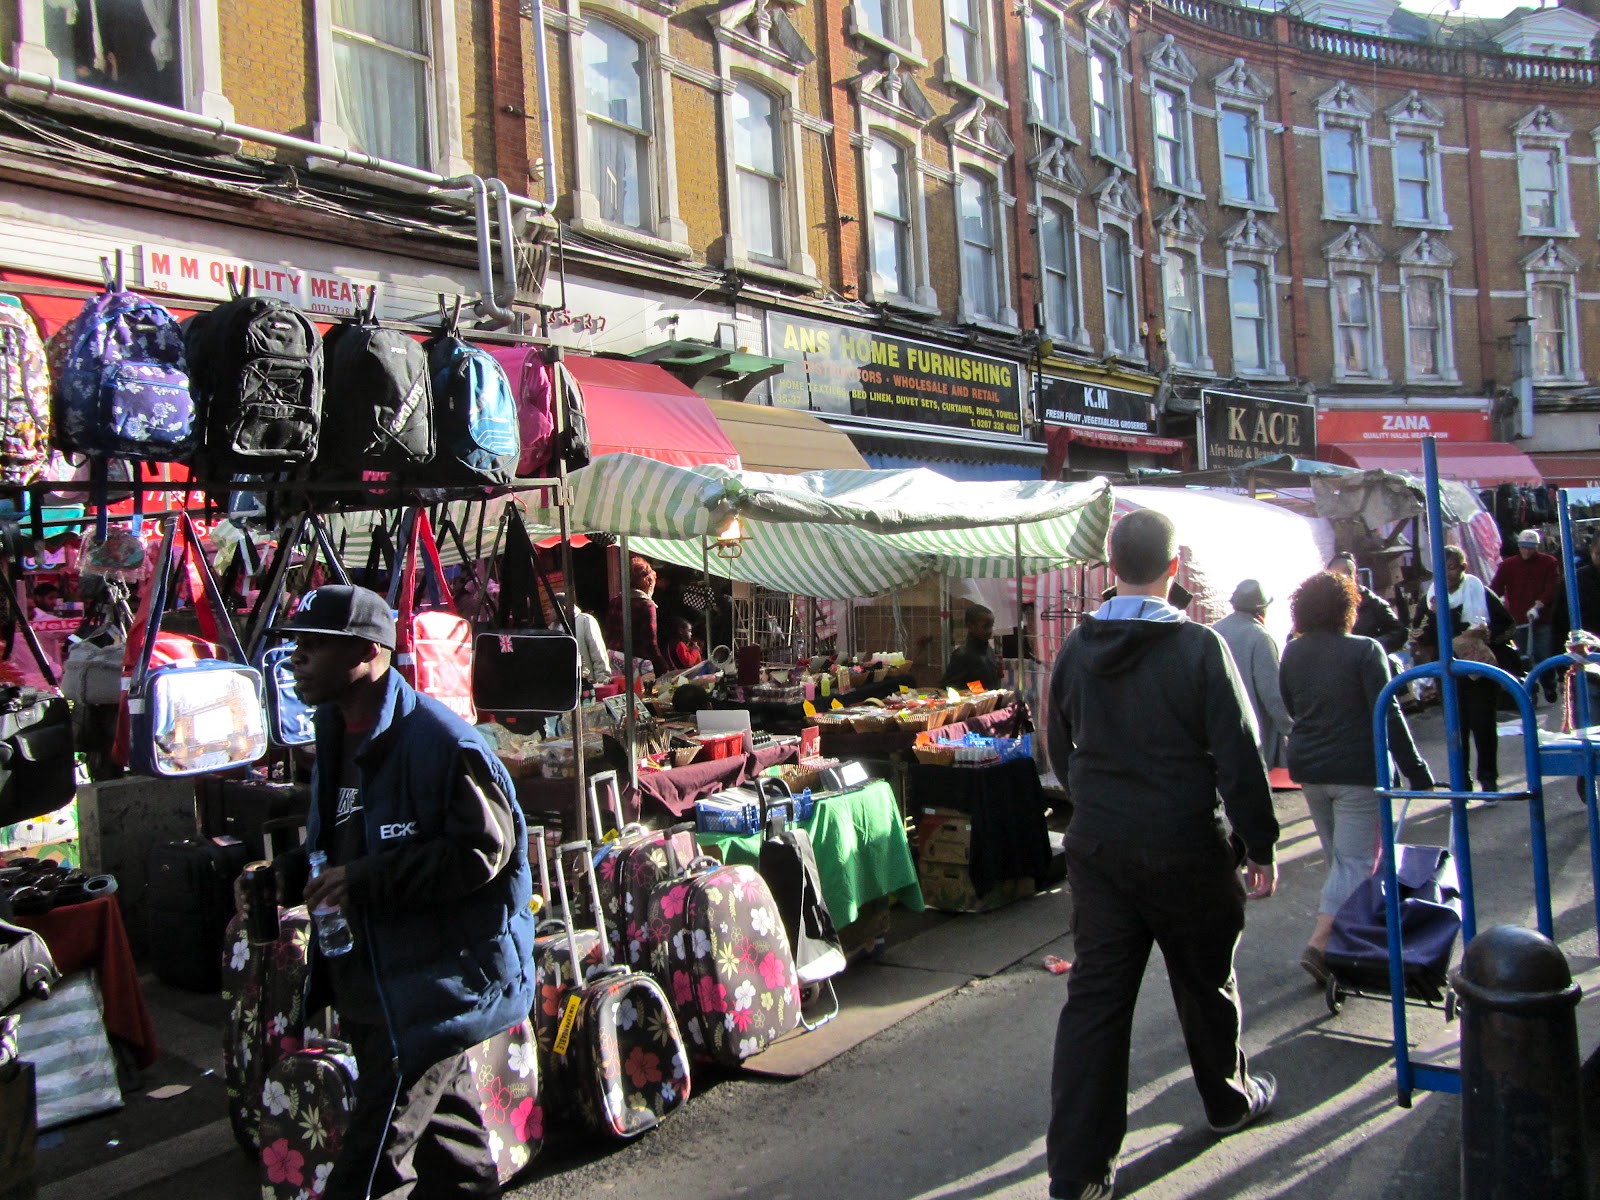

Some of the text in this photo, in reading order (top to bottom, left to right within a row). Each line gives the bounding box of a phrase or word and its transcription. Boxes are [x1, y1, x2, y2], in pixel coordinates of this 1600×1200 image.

[151, 252, 171, 276] M
[179, 256, 199, 280] M
[153, 280, 168, 292] 39
[784, 324, 1012, 388] ANS HOME FURNISHING
[779, 378, 805, 391] HOME
[851, 389, 868, 401] BED
[896, 395, 919, 407] DUVET
[996, 409, 1019, 421] TOWELS
[893, 374, 949, 395] WHOLESALE
[951, 384, 970, 398] AND
[972, 387, 1000, 403] RETAIL
[1045, 408, 1064, 420] FRESH
[1065, 411, 1081, 422] FRUIT
[1226, 406, 1301, 447] K ACE
[1382, 415, 1430, 430] ZANA
[1209, 443, 1226, 457] Afro
[1227, 444, 1245, 459] Hair
[1245, 446, 1253, 459] &
[31, 620, 81, 631] Welc
[422, 660, 438, 693] I
